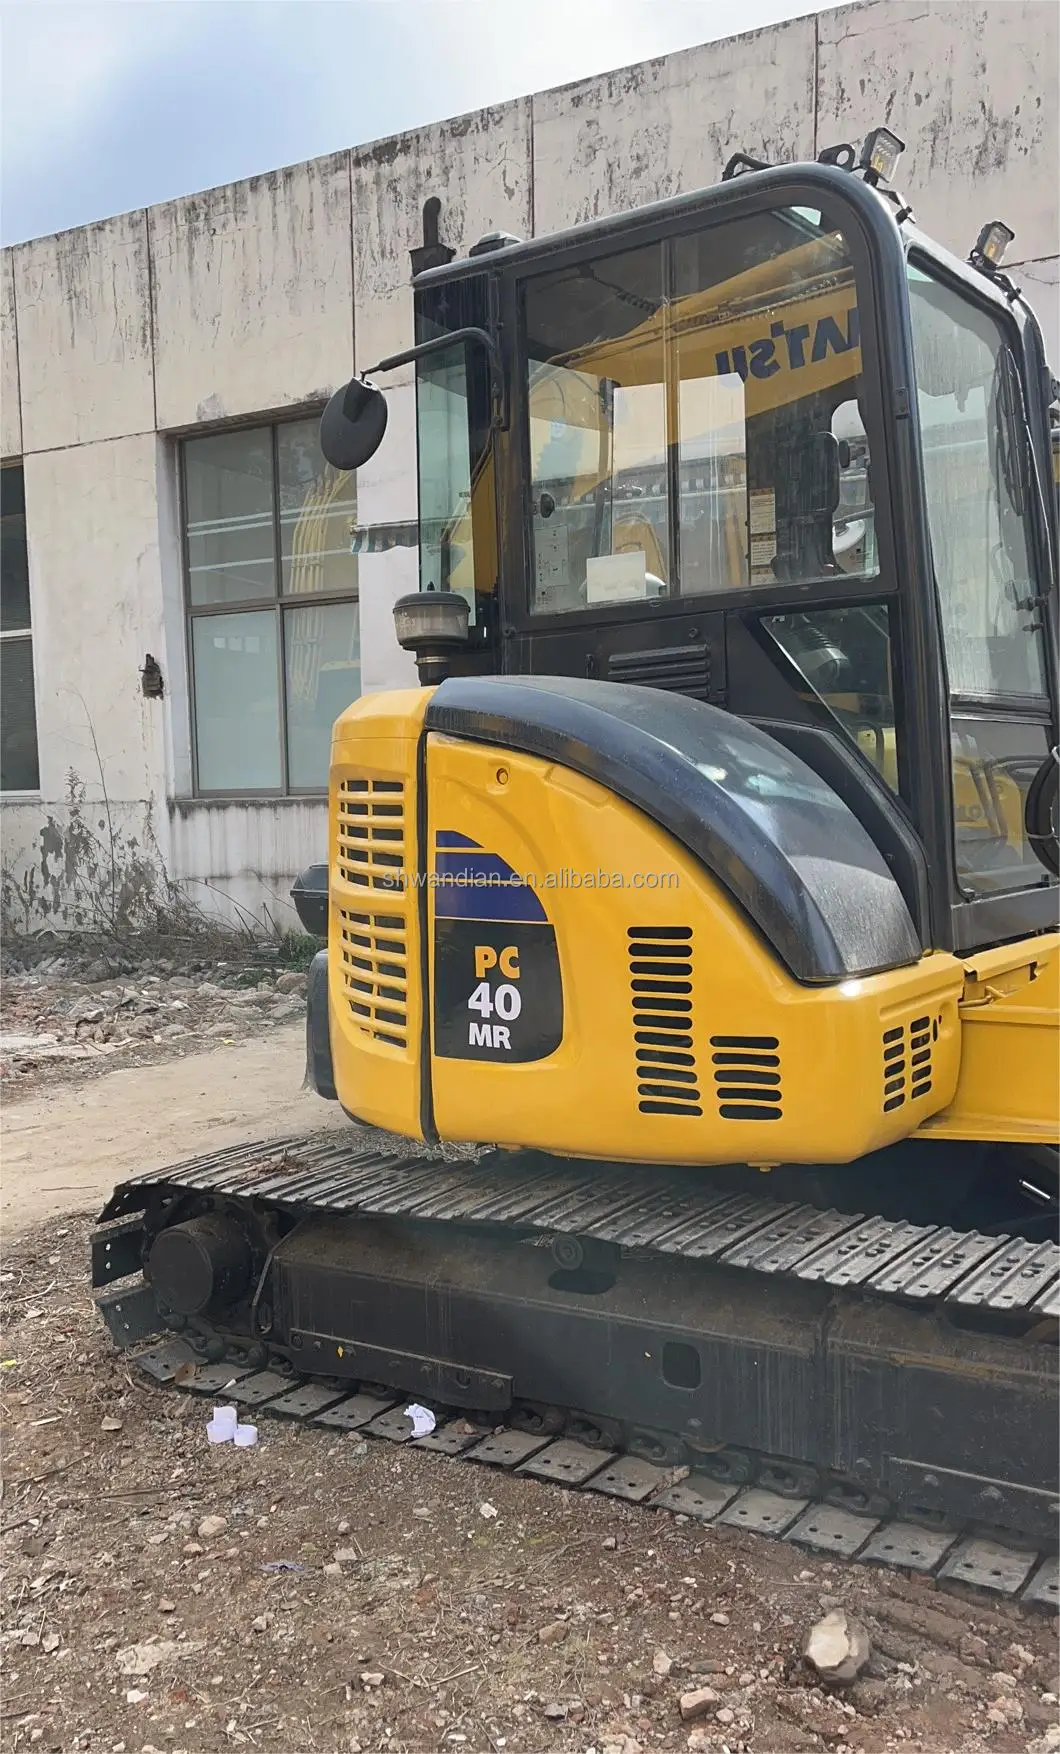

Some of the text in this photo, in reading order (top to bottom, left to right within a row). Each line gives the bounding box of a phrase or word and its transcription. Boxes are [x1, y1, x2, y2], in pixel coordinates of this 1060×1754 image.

[474, 945, 521, 979] PC
[467, 982, 522, 1021] 40
[468, 1022, 512, 1050] MR
